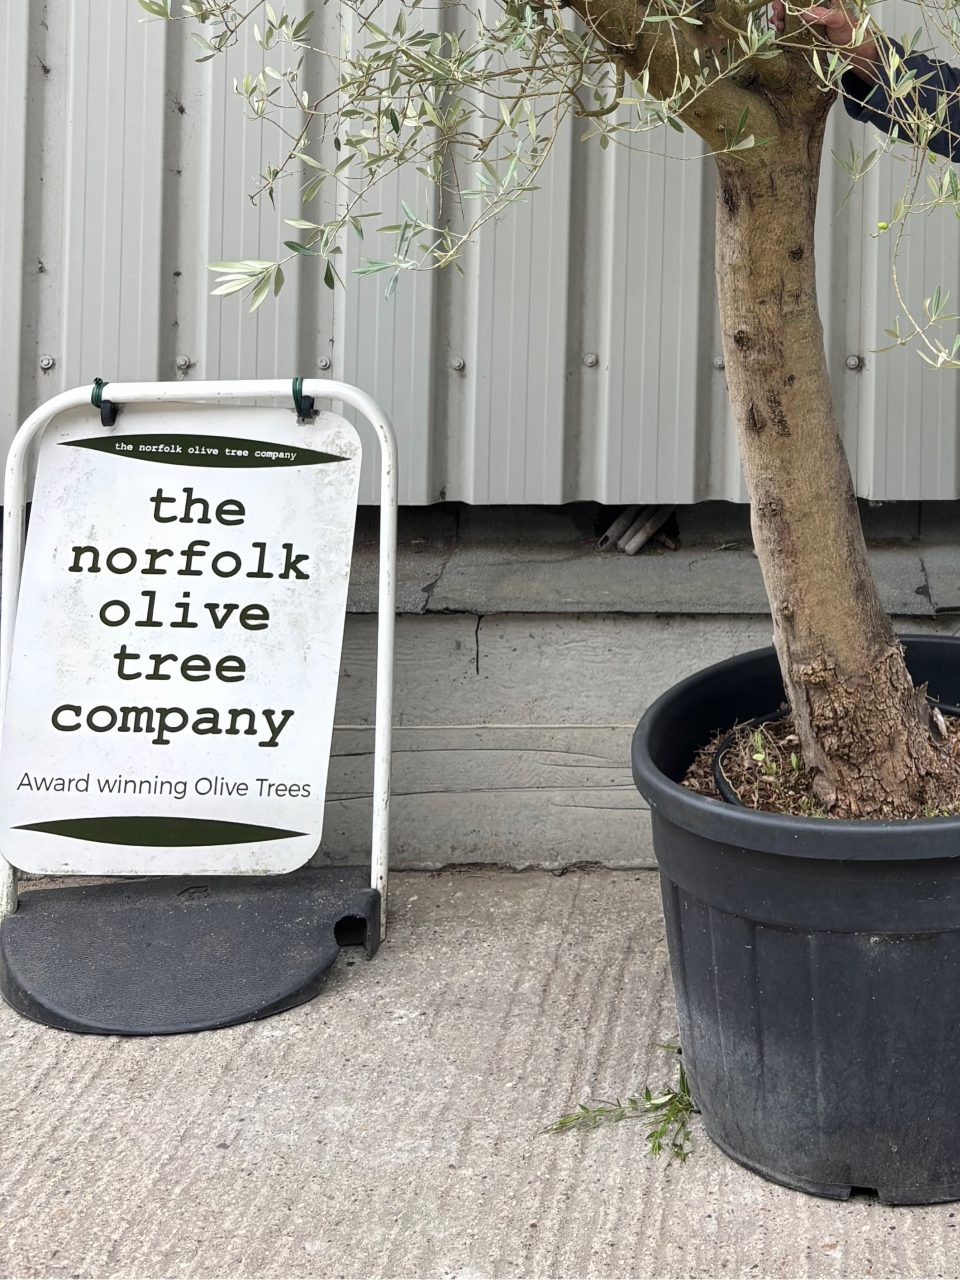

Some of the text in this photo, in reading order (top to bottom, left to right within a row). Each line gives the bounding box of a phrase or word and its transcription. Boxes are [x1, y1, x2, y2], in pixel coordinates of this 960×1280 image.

[115, 441, 297, 460] the norfolk olive tree company
[149, 487, 246, 526] the
[68, 539, 310, 580] norfolk
[99, 590, 270, 631] olive
[113, 644, 246, 683] tree
[51, 703, 295, 748] company
[16, 772, 311, 800] Award winning Olive Trees
